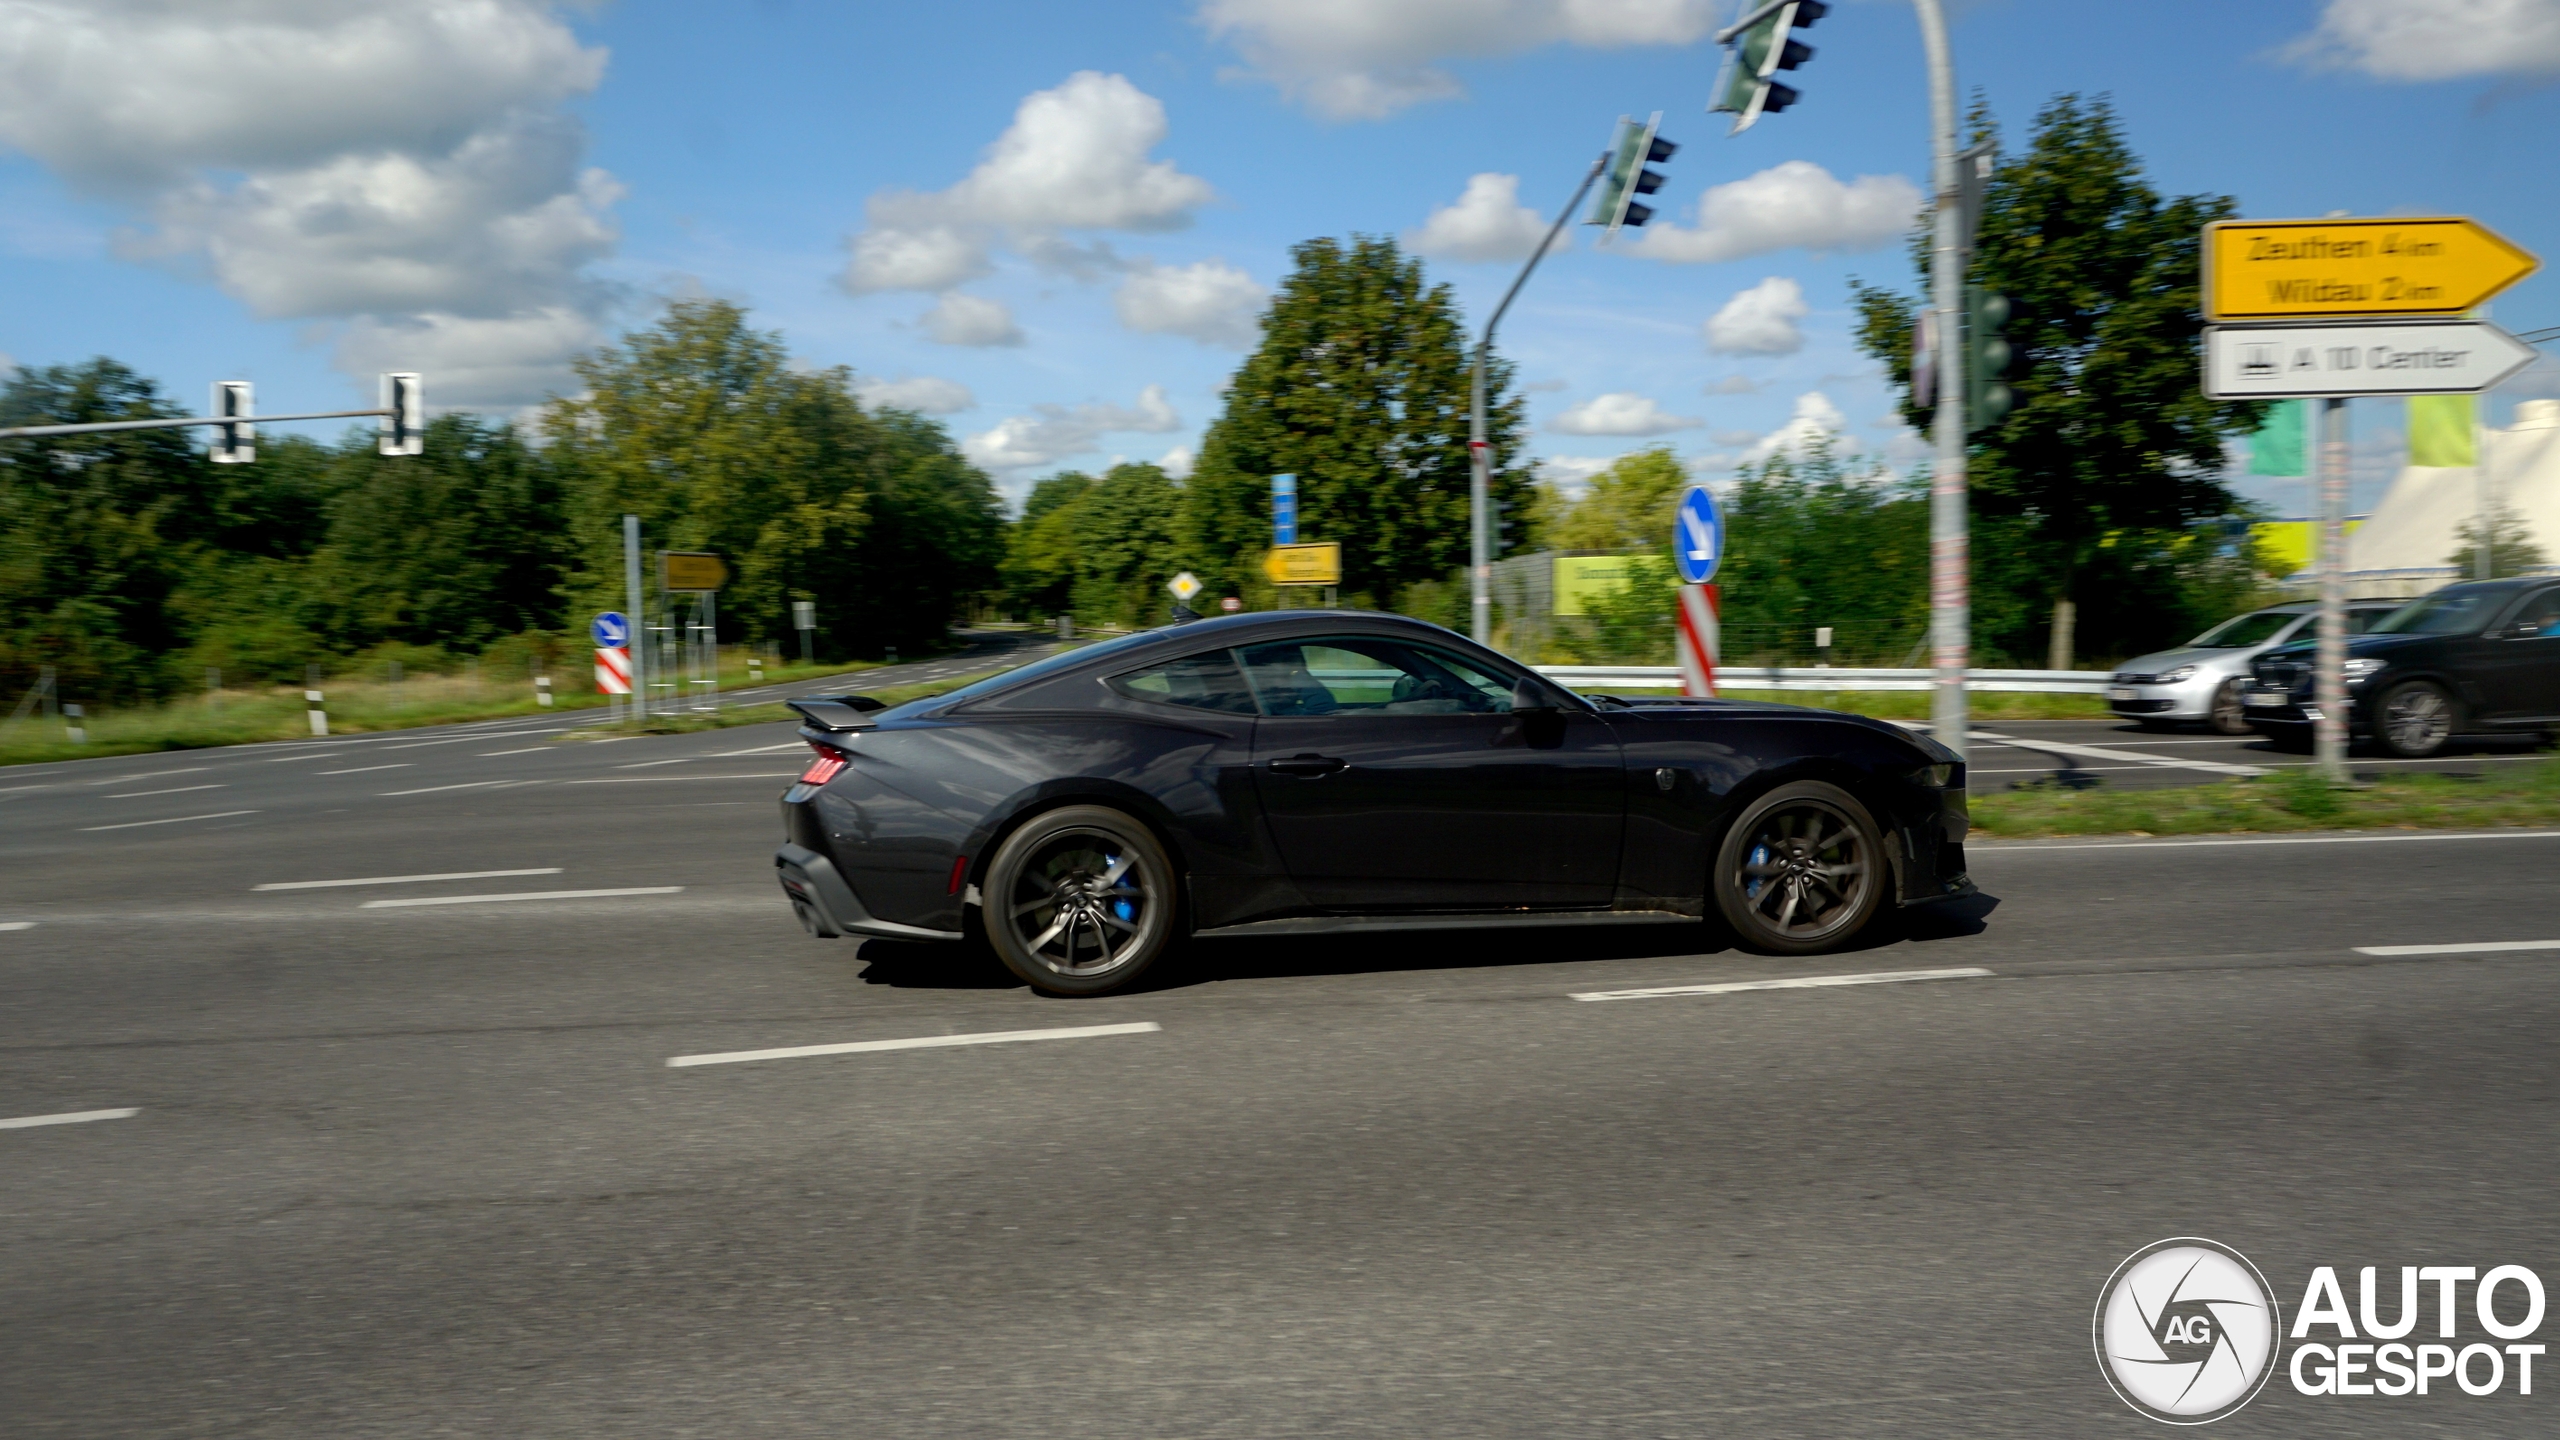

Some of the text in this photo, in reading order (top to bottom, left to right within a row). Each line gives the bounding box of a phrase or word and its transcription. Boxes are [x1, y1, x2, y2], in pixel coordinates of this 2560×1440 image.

[2247, 232, 2444, 262] Zeuthen 4 km
[2266, 276, 2444, 304] Wildau 2 km
[2288, 345, 2471, 372] A 10 Center
